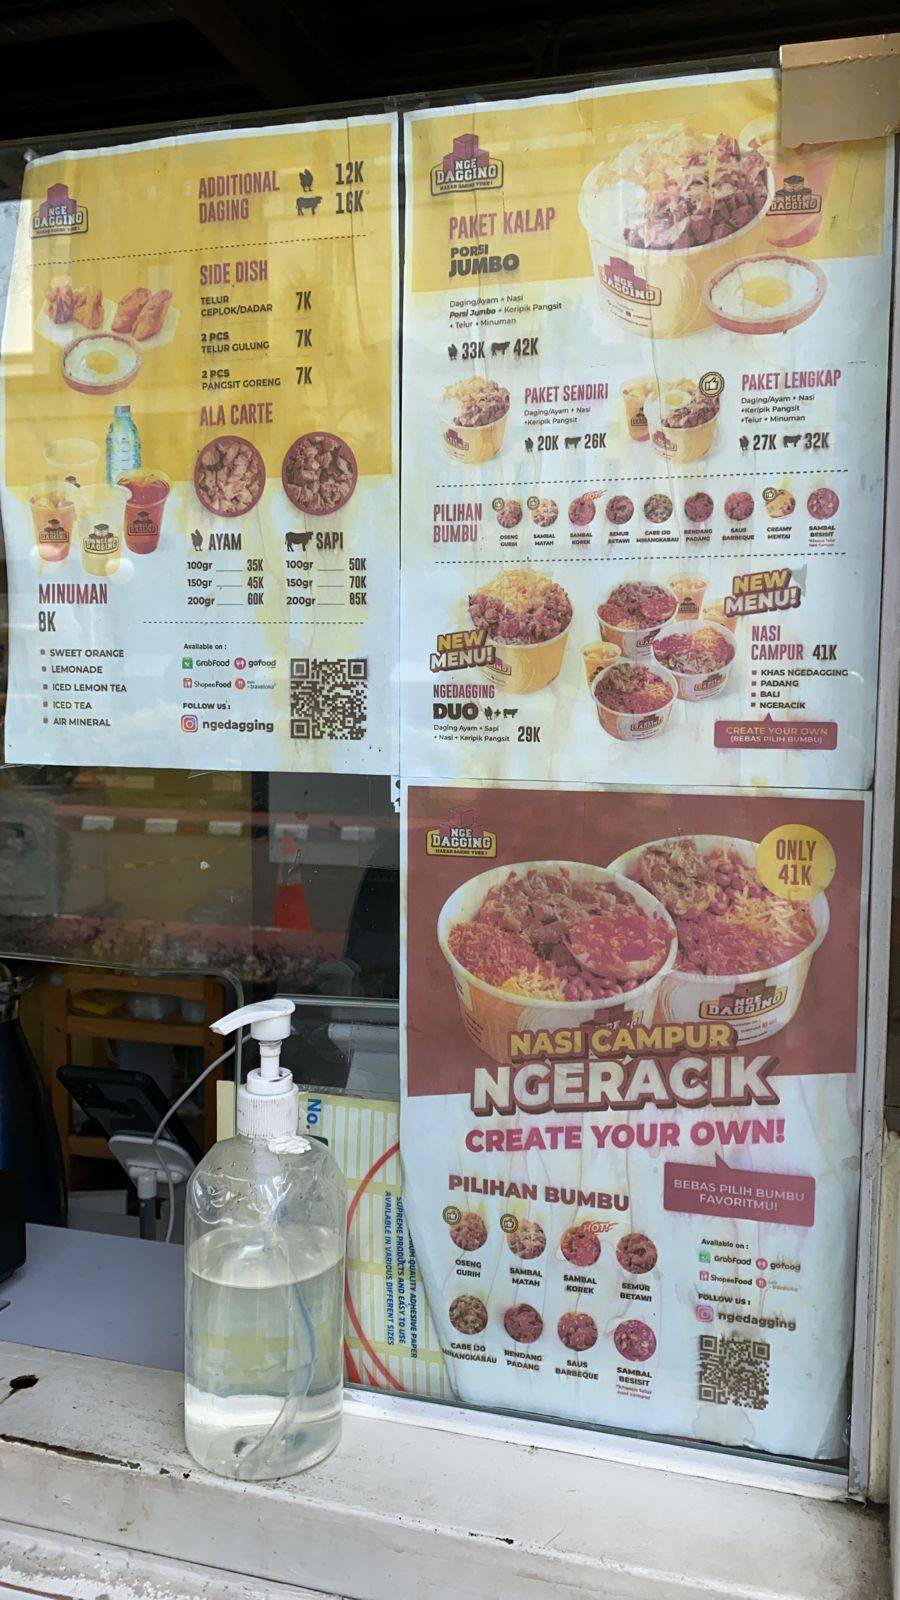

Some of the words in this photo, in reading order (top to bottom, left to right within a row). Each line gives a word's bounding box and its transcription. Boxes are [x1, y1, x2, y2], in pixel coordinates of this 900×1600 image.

[455, 158, 476, 170] NGE
[198, 170, 280, 199] ADDITIONAL
[335, 161, 364, 185] 12K
[436, 165, 497, 184] DAGGING
[48, 206, 67, 216] NGE
[199, 198, 249, 224] DAGING
[335, 190, 364, 214] 16K
[33, 212, 83, 229] DAGGING
[449, 213, 497, 240] PAKET
[503, 207, 555, 235] KALAP
[450, 244, 489, 258] PORSI
[200, 263, 231, 286] SIDE
[235, 260, 268, 284] DISH
[448, 254, 520, 278] JUMBO
[200, 295, 229, 305] TELUR
[296, 291, 312, 310] 7K
[201, 304, 273, 317] CEPLOK/DADAR
[201, 333, 207, 342] 2
[209, 332, 229, 342] PCS
[296, 329, 312, 348] 7K
[201, 344, 230, 354] TELUR
[232, 341, 270, 352] GULUNG
[461, 341, 485, 360] 33K
[513, 337, 539, 357] 42K
[201, 370, 208, 379] 2
[209, 369, 230, 378] PCS
[296, 367, 312, 385] 7K
[202, 380, 240, 390] PANGSIT
[243, 378, 281, 388] GORENG
[741, 372, 780, 391] PAKET
[784, 369, 842, 389] LENGKAP
[524, 386, 559, 404] PAKET
[563, 383, 609, 402] SENDIRI
[741, 396, 791, 404] Daging/Ayam
[200, 405, 226, 426] ALA
[231, 402, 273, 425] CARTE
[772, 405, 800, 413] Pangsit
[537, 435, 558, 451] 20K
[584, 432, 607, 449] 26K
[753, 434, 776, 451] 27K
[804, 432, 830, 449] 32K
[433, 503, 482, 522] PILIHAN
[208, 533, 242, 551] AYAM
[316, 532, 343, 550] SAPI
[433, 525, 477, 543] BUMBU
[187, 561, 213, 572] 100gr
[247, 559, 264, 572] 35K
[286, 560, 314, 571] 100gr
[349, 558, 366, 571] 50K
[187, 578, 213, 589] 150gr
[247, 576, 264, 589] 45K
[286, 578, 313, 589] 150gr
[349, 575, 367, 589] 70K
[734, 569, 790, 594] NEW
[38, 583, 108, 604] MINUMAN
[187, 597, 215, 607] 200gr
[247, 593, 264, 605] 60K
[287, 596, 316, 607] 200gr
[349, 593, 367, 605] 85K
[725, 587, 800, 615] MENU!
[38, 611, 56, 632] 8K
[437, 629, 487, 652] NEW
[752, 625, 781, 642] NASI
[49, 649, 82, 657] SWEET
[84, 649, 125, 658] ORANGE
[431, 647, 495, 671] MENU!
[751, 644, 803, 661] CAMPUR
[813, 644, 837, 660] 41K
[51, 665, 103, 673] LEMONADE
[195, 659, 230, 667] GrabFood
[248, 659, 276, 668] gofood
[761, 668, 786, 676] KHAS
[52, 683, 72, 691] ICED
[74, 684, 108, 692] LEMON
[110, 684, 127, 692] TEA
[433, 684, 495, 699] NGEDAGGING
[760, 690, 780, 698] BALI
[53, 701, 72, 709] ICED
[433, 703, 479, 720] DUO
[68, 718, 111, 727] MINERAL
[202, 719, 274, 732] ngedagging
[518, 726, 541, 743] 29K
[726, 727, 766, 735] CREATE
[768, 727, 798, 735] YOUR
[800, 728, 828, 736] OWN
[730, 735, 761, 743] (BEBAS
[787, 736, 822, 744] BUMBU)
[432, 834, 491, 848] DAGGING
[451, 828, 473, 838] NGE
[776, 839, 816, 861] ONLY
[778, 864, 812, 886] 41K
[510, 1030, 582, 1057] NASI
[591, 1024, 731, 1053] CAMPUR
[473, 1055, 773, 1109] NGERACIK
[306, 1098, 322, 1129] No.
[465, 1126, 582, 1153] CREATE
[591, 1121, 680, 1149] YOUR
[690, 1118, 786, 1146] OWN!
[448, 1175, 538, 1201] PILIHAN
[544, 1186, 630, 1212] BUMBU
[673, 1179, 716, 1192] BEBAS
[719, 1184, 752, 1196] PILIH
[756, 1188, 805, 1202] BUMBU
[699, 1194, 778, 1211] FAVORITMU!
[384, 1191, 392, 1235] AVAILABLE
[396, 1196, 404, 1233] SUPREME
[583, 1223, 609, 1234] HOT!
[385, 1236, 392, 1244] IN
[385, 1246, 393, 1280] VARIOUS
[396, 1236, 405, 1276] PRODUCTS
[455, 1258, 482, 1269] OSENG
[714, 1255, 751, 1266] GrabFood
[770, 1262, 801, 1273] gofood
[408, 1259, 417, 1292] QUALITY
[456, 1269, 481, 1278] GURIH
[509, 1267, 543, 1278] SAMBAL
[563, 1274, 597, 1285] SAMBAL
[710, 1275, 752, 1286] ShopeeFood
[397, 1277, 405, 1294] AND
[512, 1277, 540, 1287] MATAH
[566, 1285, 595, 1294] KOREK
[621, 1282, 650, 1292] SEMUR
[386, 1282, 394, 1323] DIFFERENT
[620, 1292, 652, 1302] BETAWI
[698, 1293, 733, 1304] FOLLOW
[409, 1293, 418, 1331] ADHESIVE
[398, 1316, 405, 1327] TO
[717, 1311, 796, 1331] ngedagging
[410, 1333, 418, 1359] PAPER
[450, 1342, 472, 1352] CABE
[504, 1349, 542, 1362] RENDANG
[566, 1360, 588, 1368] SAUS
[506, 1360, 540, 1371] PADANG
[555, 1368, 599, 1380] BARBEQUE
[616, 1366, 653, 1379] SAMBAL
[618, 1376, 650, 1387] BESISIT
